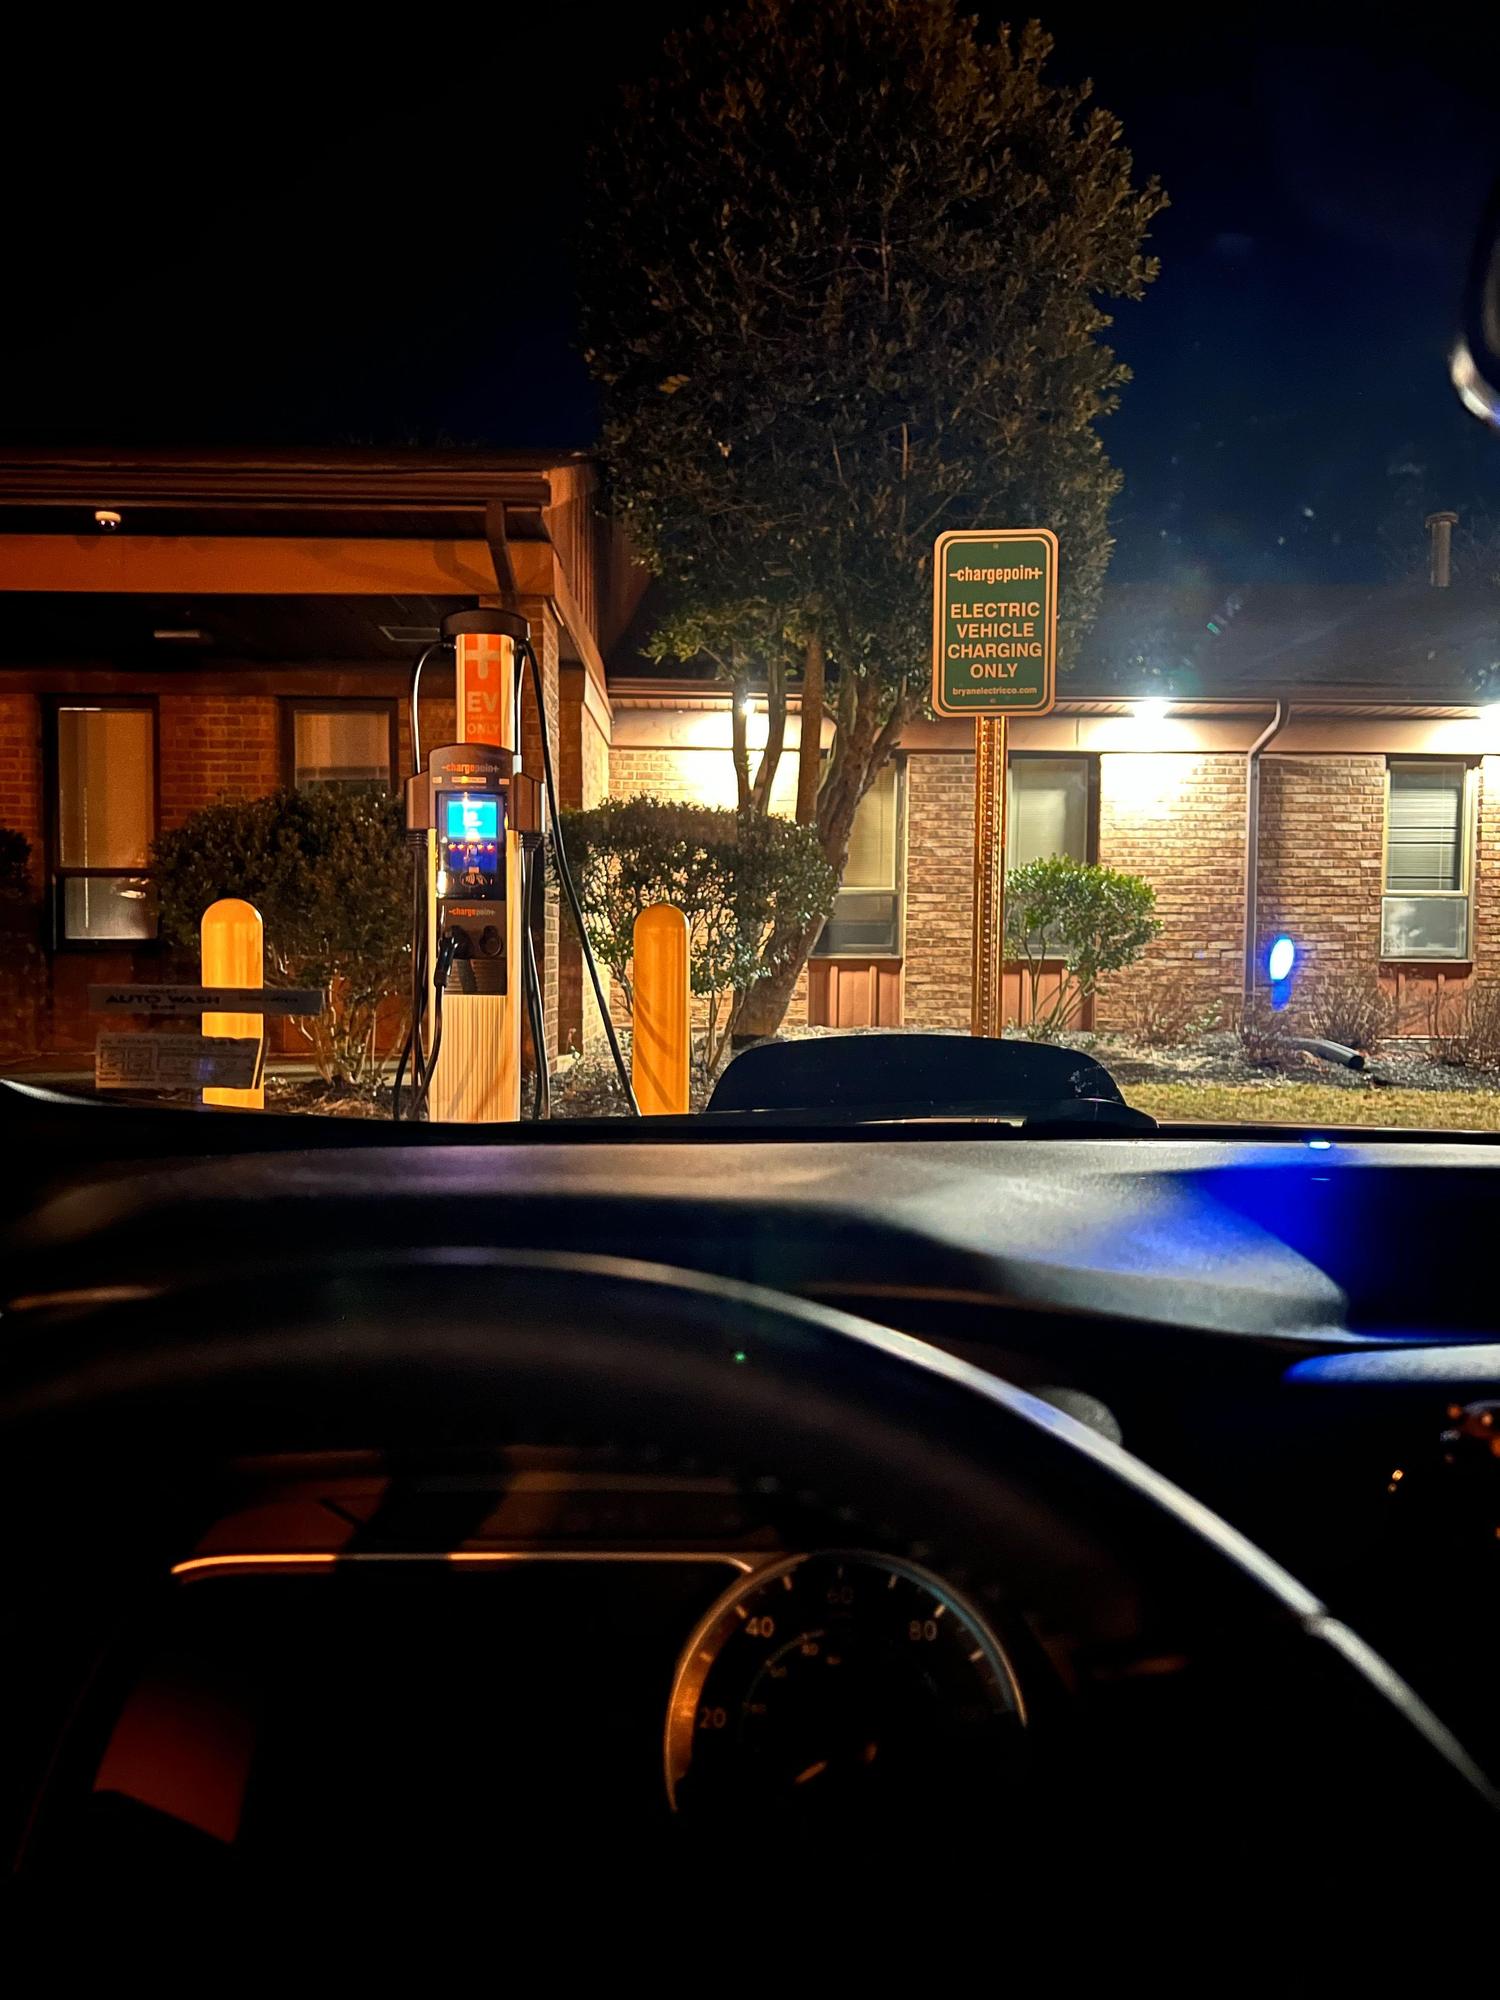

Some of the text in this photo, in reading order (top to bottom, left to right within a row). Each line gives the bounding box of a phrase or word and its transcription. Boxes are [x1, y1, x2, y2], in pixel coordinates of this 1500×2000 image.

[949, 565, 1043, 584] chargepoint
[951, 602, 1040, 619] ELECTRIC
[956, 622, 1034, 639] VEHICLE
[947, 642, 1042, 659] CHARGING
[970, 663, 1018, 678] ONLY
[952, 687, 1037, 697] bryanelectricco.com
[467, 691, 498, 713] EV
[466, 722, 500, 736] ONLY
[106, 995, 220, 1005] AUTO WASH
[745, 1616, 775, 1638] 40
[909, 1619, 938, 1642] 80
[700, 1706, 727, 1729] 20
